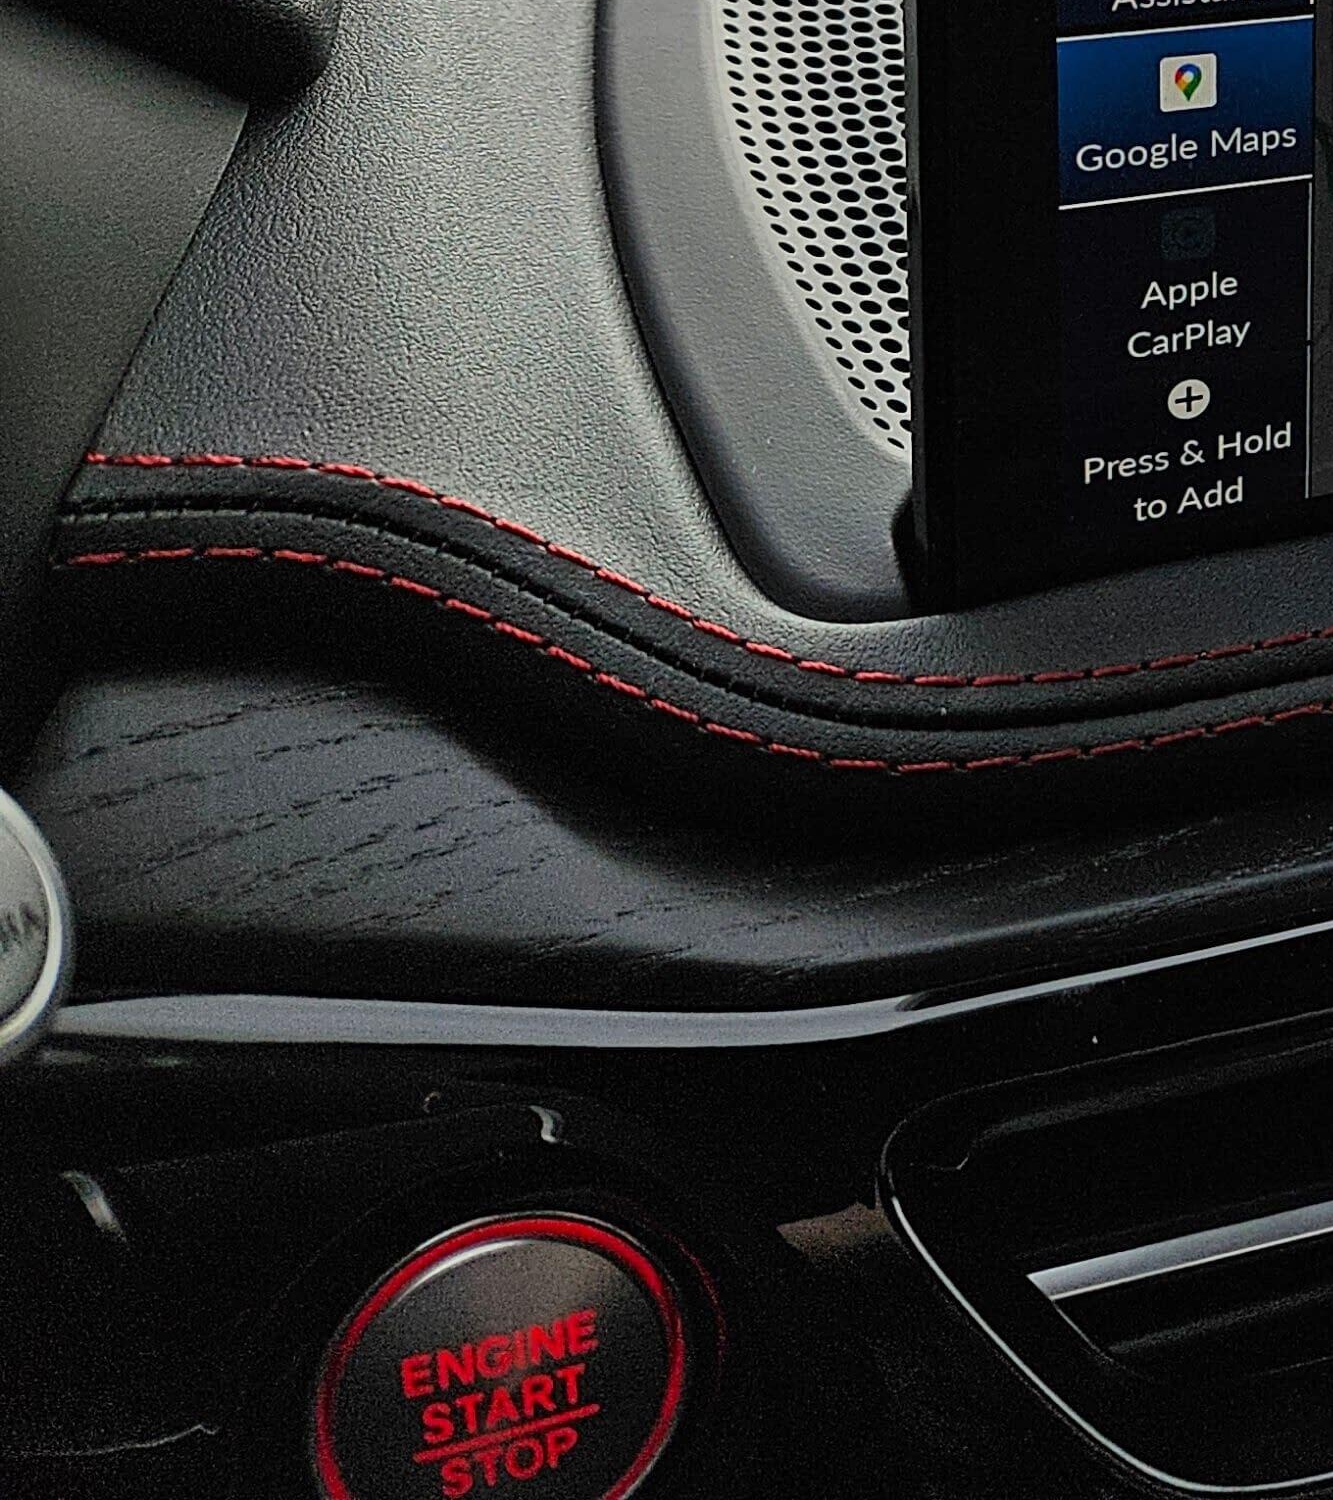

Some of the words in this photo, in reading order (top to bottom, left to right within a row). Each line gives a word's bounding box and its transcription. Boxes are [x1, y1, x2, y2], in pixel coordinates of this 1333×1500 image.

[1075, 132, 1198, 175] Google
[1211, 124, 1298, 162] Maps
[1141, 272, 1239, 312] Apple
[1127, 316, 1252, 362] CarPlay
[1083, 452, 1170, 486] Press
[1180, 439, 1206, 467] &
[1218, 422, 1293, 460] Hold
[1134, 491, 1166, 522] to
[1177, 475, 1244, 515] Add
[401, 1307, 599, 1399] ENGINE
[422, 1364, 586, 1445] START
[439, 1427, 580, 1499] STOP
